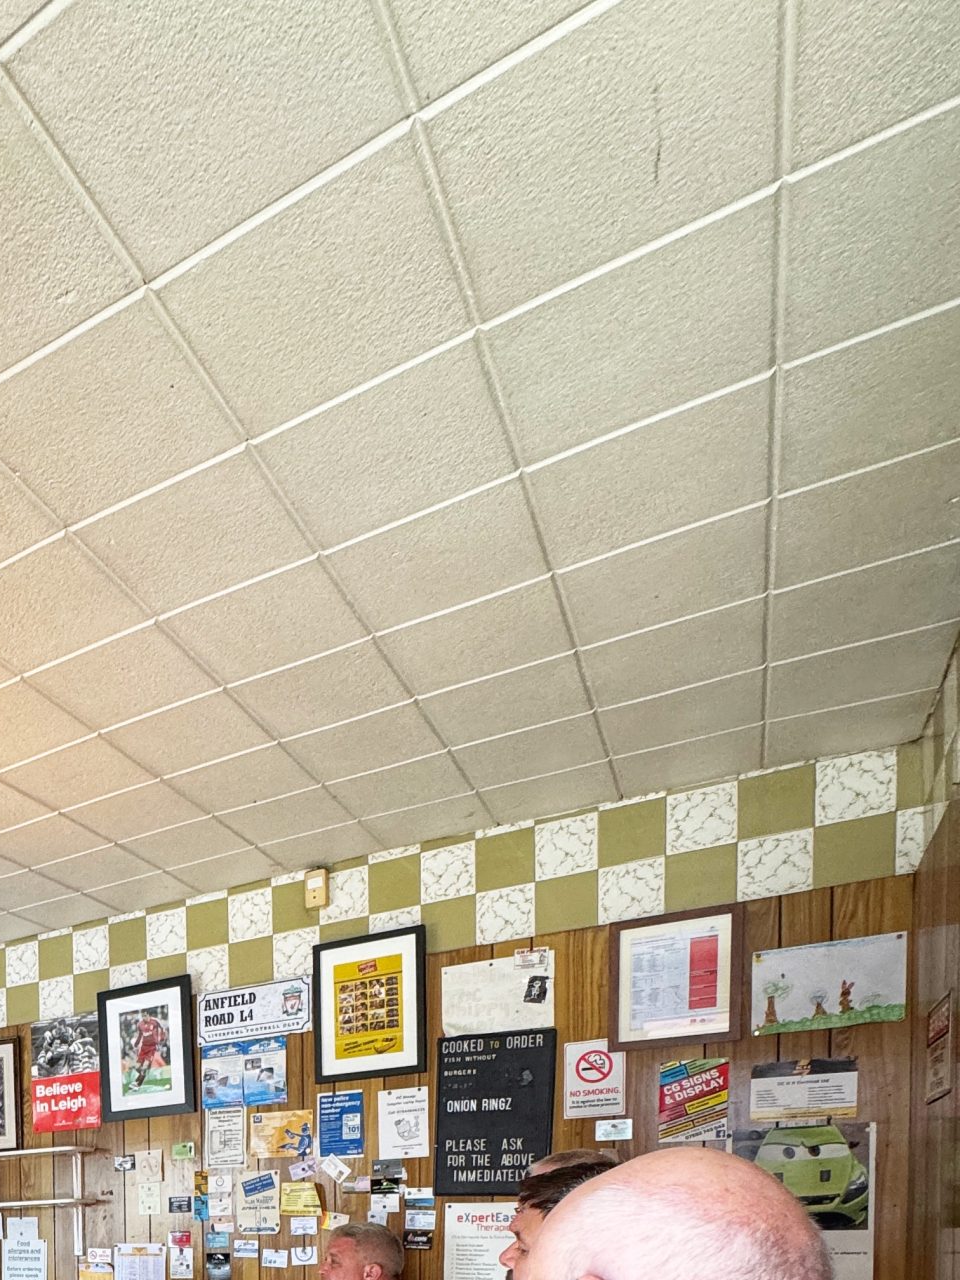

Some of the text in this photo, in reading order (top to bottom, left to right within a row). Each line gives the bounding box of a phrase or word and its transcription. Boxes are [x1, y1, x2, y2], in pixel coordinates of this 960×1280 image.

[204, 992, 257, 1011] ANFIELD
[204, 1009, 254, 1027] ROAD L4
[207, 1029, 244, 1039] LIVERPOOL
[246, 1024, 280, 1033] FOOTBALL
[442, 1034, 544, 1054] COOKED TO ORDER
[465, 1054, 497, 1062] WITHOUT
[443, 1069, 477, 1077] BURGERS
[35, 1082, 83, 1098] Believe
[663, 1083, 680, 1095] CG
[681, 1069, 719, 1089] SIGNS
[664, 1076, 724, 1105] & DISPLAY
[36, 1095, 87, 1113] in Leigh
[446, 1097, 512, 1113] ONION RINGZ
[445, 1138, 524, 1152] PLEASE ASK
[447, 1153, 535, 1167] FOR THE ABOVE
[453, 1169, 527, 1182] IMMEDIATELY
